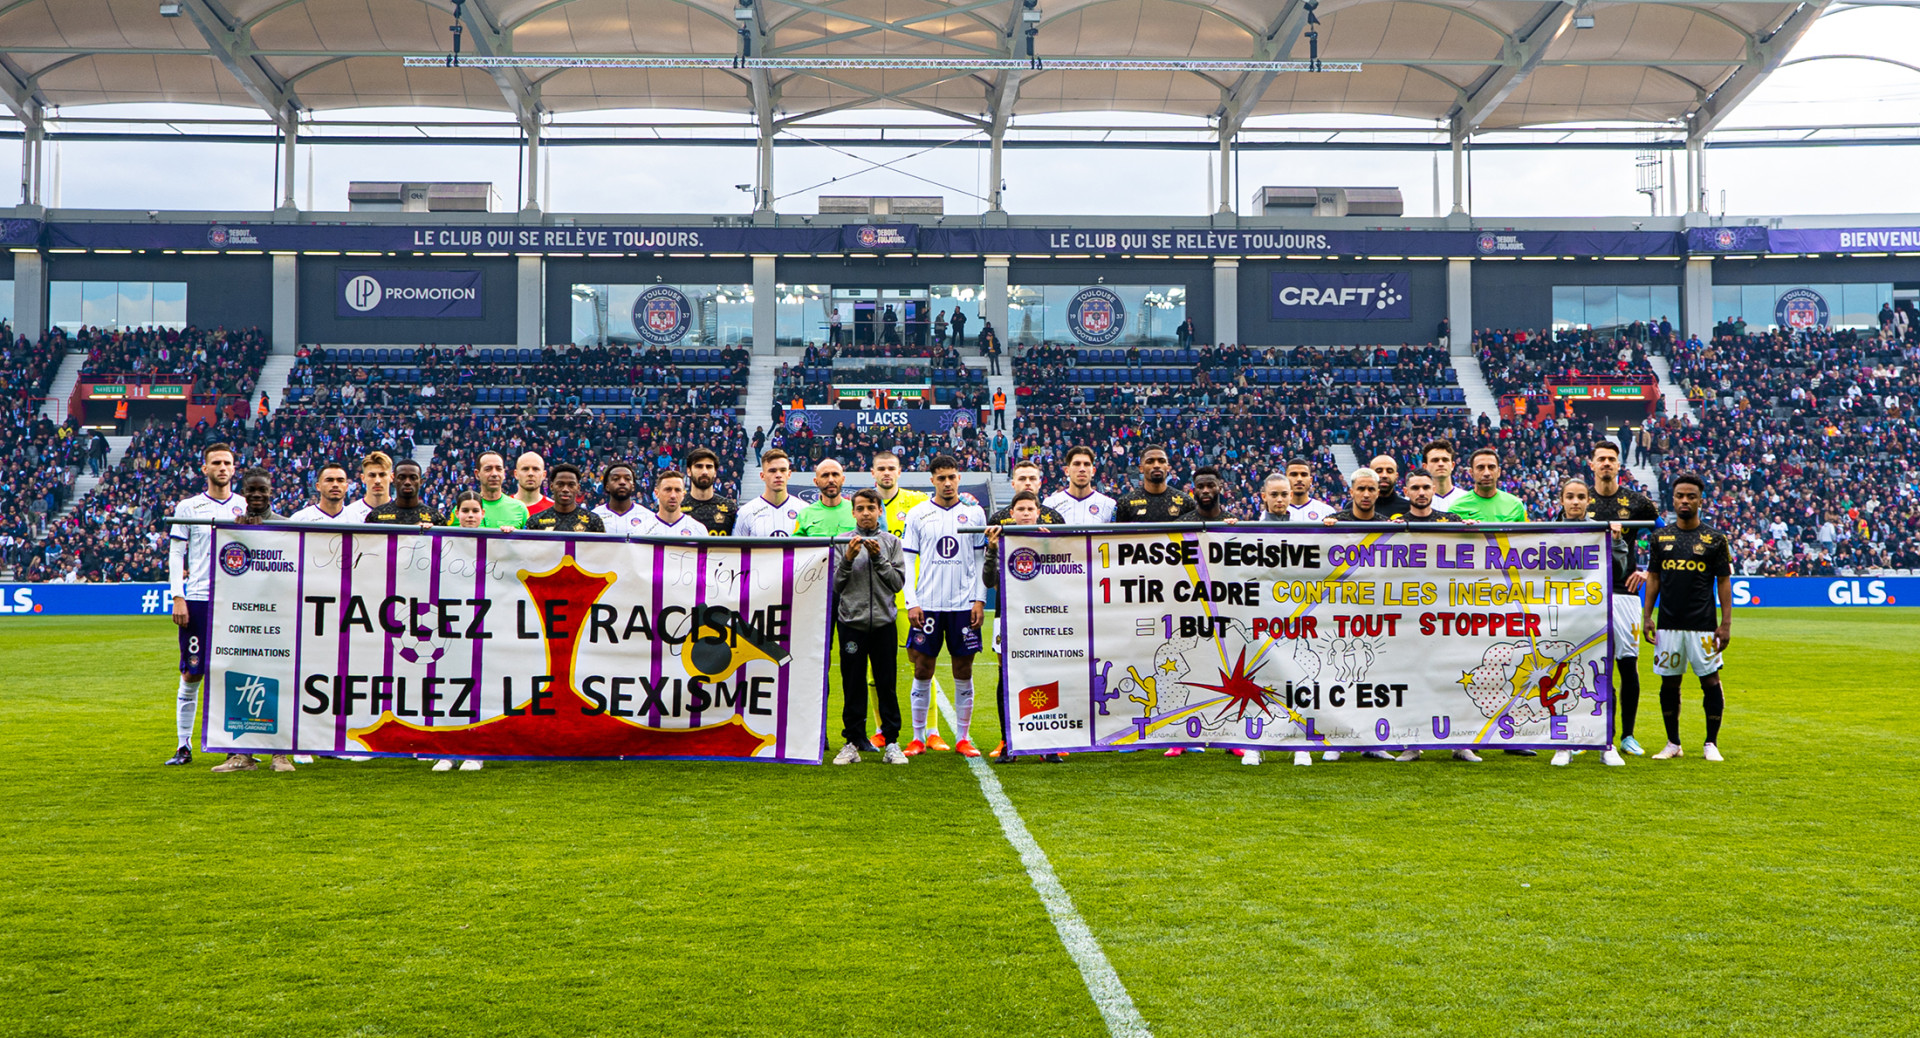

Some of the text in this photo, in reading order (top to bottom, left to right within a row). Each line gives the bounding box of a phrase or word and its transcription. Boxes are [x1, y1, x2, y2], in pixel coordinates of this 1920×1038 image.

[414, 228, 704, 247] LE CLUB QUI SE RELÈVE TOUJOURS.
[1050, 231, 1331, 251] LE CLUB QUI SE RELÈVE TOUJOURS.
[385, 287, 476, 300] PROMOTION
[642, 289, 682, 302] TOULOUSE
[1077, 290, 1116, 303] TOULOUSE
[1279, 286, 1376, 306] CRAFT
[1783, 290, 1820, 303] TOULOUSE
[640, 325, 686, 342] FOOTBALL CLUB
[1074, 326, 1119, 342] FOOTBALL CLUB
[134, 387, 144, 396] 11
[1592, 388, 1605, 397] 14
[857, 411, 908, 425] PLACES
[250, 549, 286, 561] DEBOUT.
[1040, 553, 1075, 564] DEBOUT.
[1098, 543, 1110, 568] 1
[1118, 540, 1199, 566] PASSE
[1328, 543, 1427, 568] CONTRE
[1436, 543, 1475, 569] LE
[1485, 541, 1600, 570] RACISME
[251, 560, 297, 573] TOUJOURS.
[1041, 563, 1086, 575] TOUJOURS.
[1099, 577, 1111, 604] 1
[1120, 575, 1164, 604] TIR
[1173, 577, 1260, 607] CADRÉ
[1272, 580, 1375, 606] CONTRE
[1383, 581, 1438, 607] LES
[1828, 580, 1896, 605] GLS.
[232, 602, 277, 613] ENSEMBLE
[1024, 605, 1069, 615] ENSEMBLE
[304, 595, 790, 649] TACLEZ LE RACISME
[923, 617, 935, 635] 8
[1180, 615, 1231, 639] BUT
[1252, 614, 1318, 640] POUR
[1333, 613, 1402, 638] TOUT
[1419, 612, 1541, 637] STOPPER
[228, 624, 281, 635] CONTRE LES
[1022, 626, 1074, 636] CONTRE LES
[188, 635, 200, 654] 8
[215, 646, 290, 658] DISCRIMINATIONS
[1011, 648, 1084, 659] DISCRIMINATIONS
[1659, 651, 1681, 669] 20
[302, 674, 775, 718] SIFFLEZ LE SEXISME
[1285, 681, 1408, 710] ICI C'EST
[1032, 713, 1056, 721] MAIRIE
[1018, 719, 1083, 732] TOULOUSE
